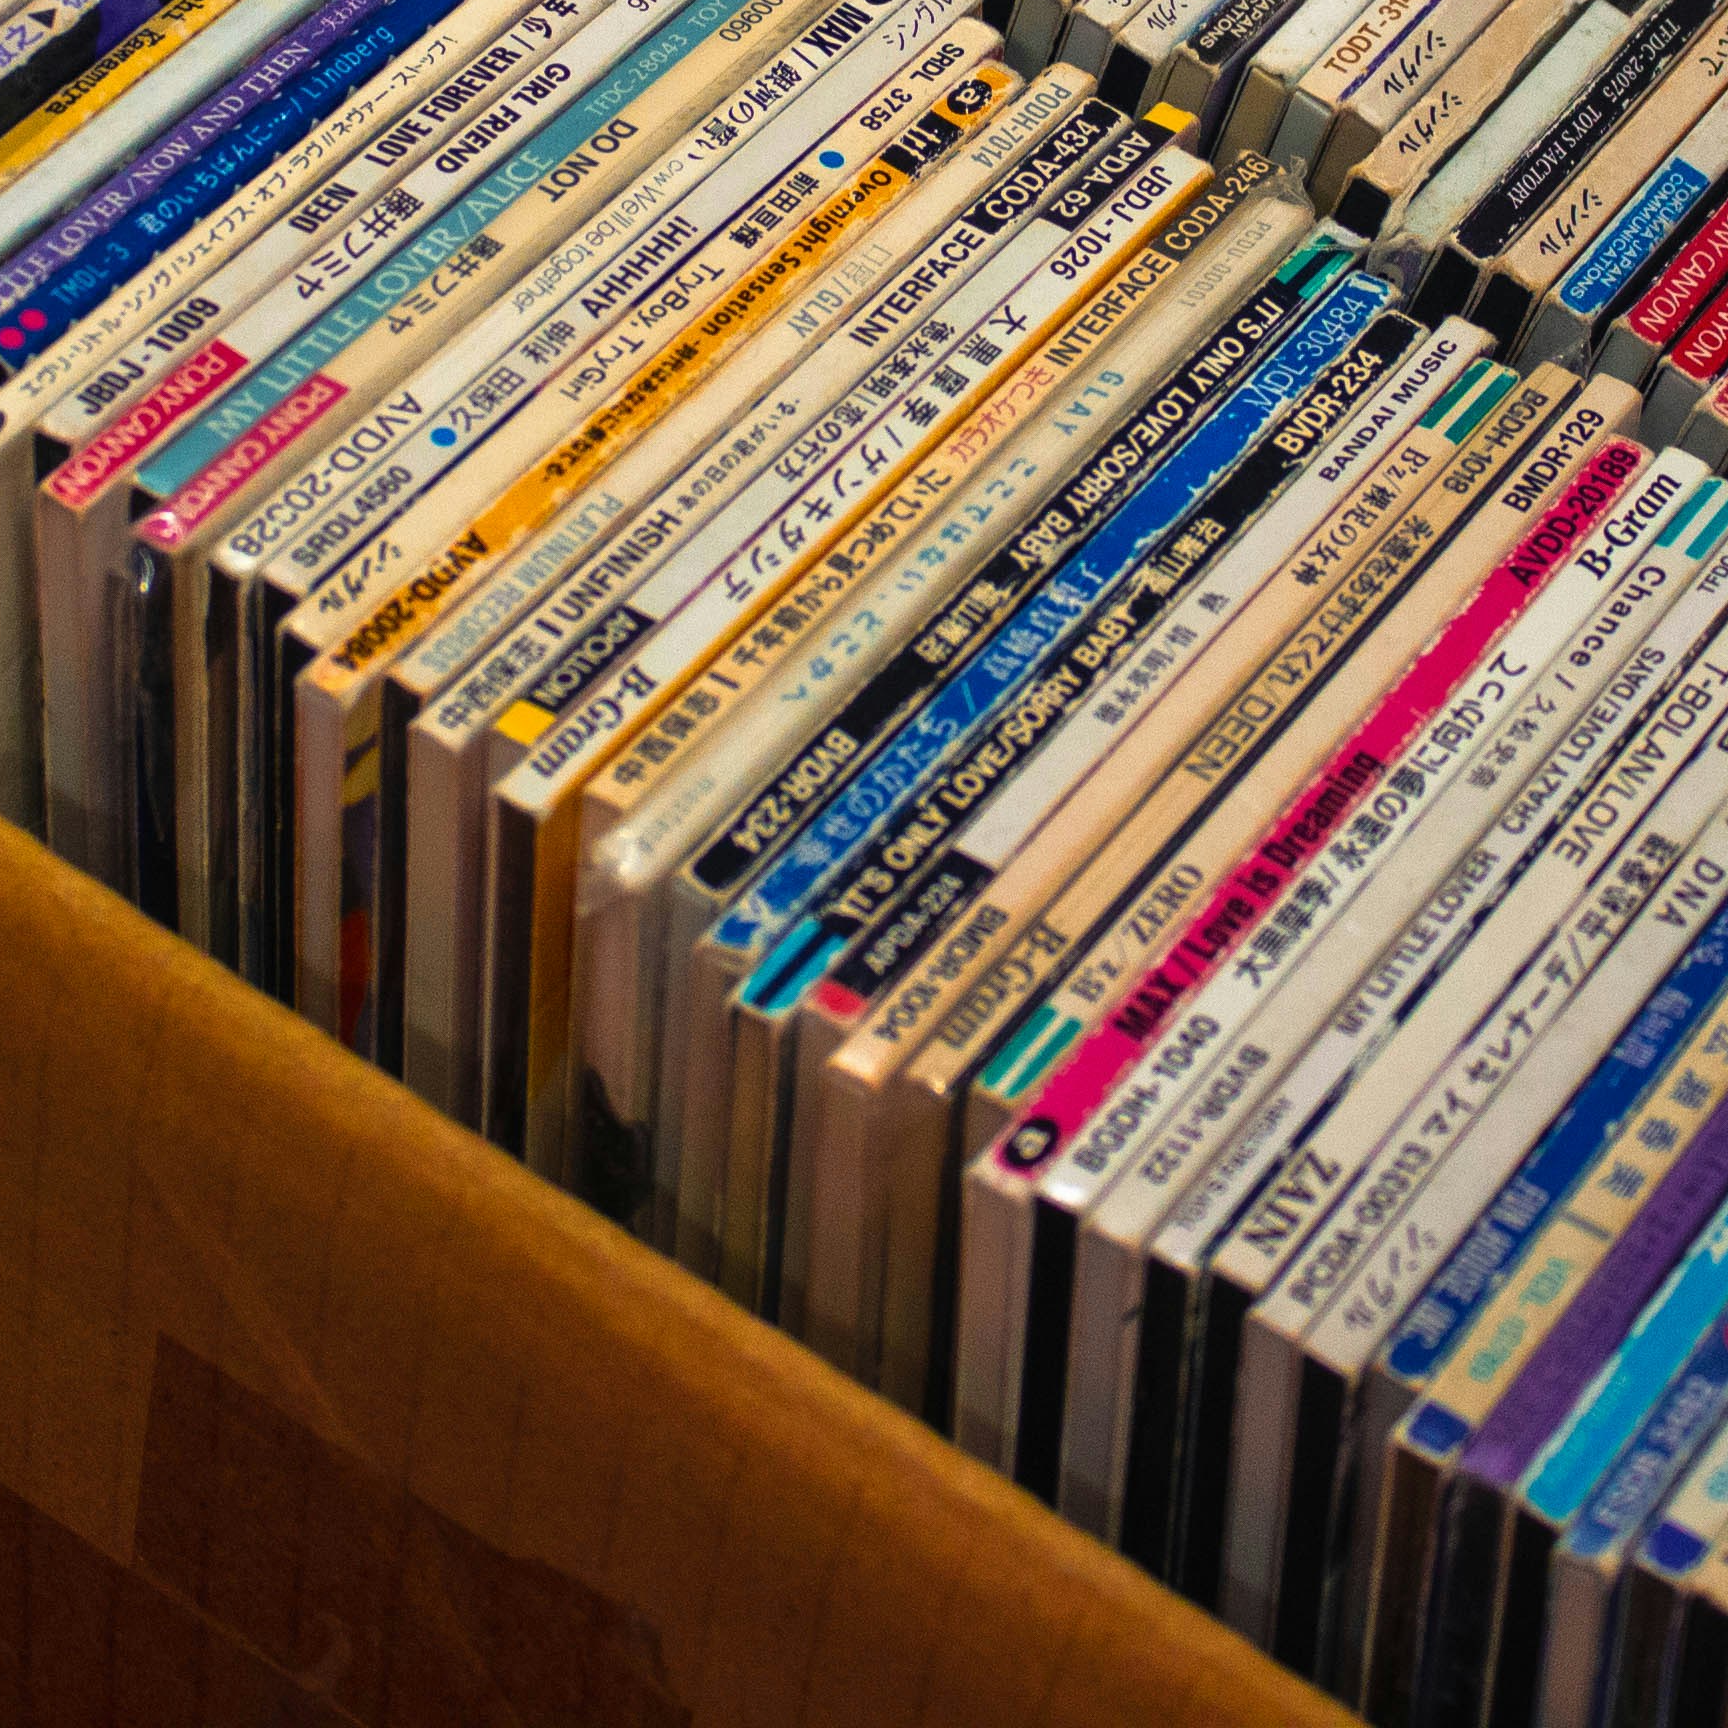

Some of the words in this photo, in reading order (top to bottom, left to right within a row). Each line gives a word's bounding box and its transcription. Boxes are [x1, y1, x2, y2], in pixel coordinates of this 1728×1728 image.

[285, 179, 361, 238] DEEN
[362, 114, 436, 171] LOVE
[419, 42, 524, 124] FOREVER
[430, 105, 522, 177] FRIEND
[508, 59, 577, 113] GIRL
[258, 304, 368, 394] LITTLE
[355, 145, 557, 312] LOVER/ALICE
[442, 364, 528, 433] 久保田
[519, 316, 583, 367] 利伸
[573, 212, 701, 319] AHHHHH!
[1040, 249, 1177, 370] INTERFACE
[1160, 154, 1274, 253] CODA-246
[1267, 345, 1389, 456] BVDR-234
[1311, 401, 1401, 484] BANDAI
[1386, 336, 1464, 406] MUSIC
[1499, 444, 1646, 587] AVDD-20189
[1573, 469, 1690, 582] B-Gram
[525, 662, 660, 781] B-Gram
[1116, 860, 1209, 947] ZERO
[1497, 405, 1612, 514] BMDR-129
[1554, 644, 1675, 766] LOVE/DAYS
